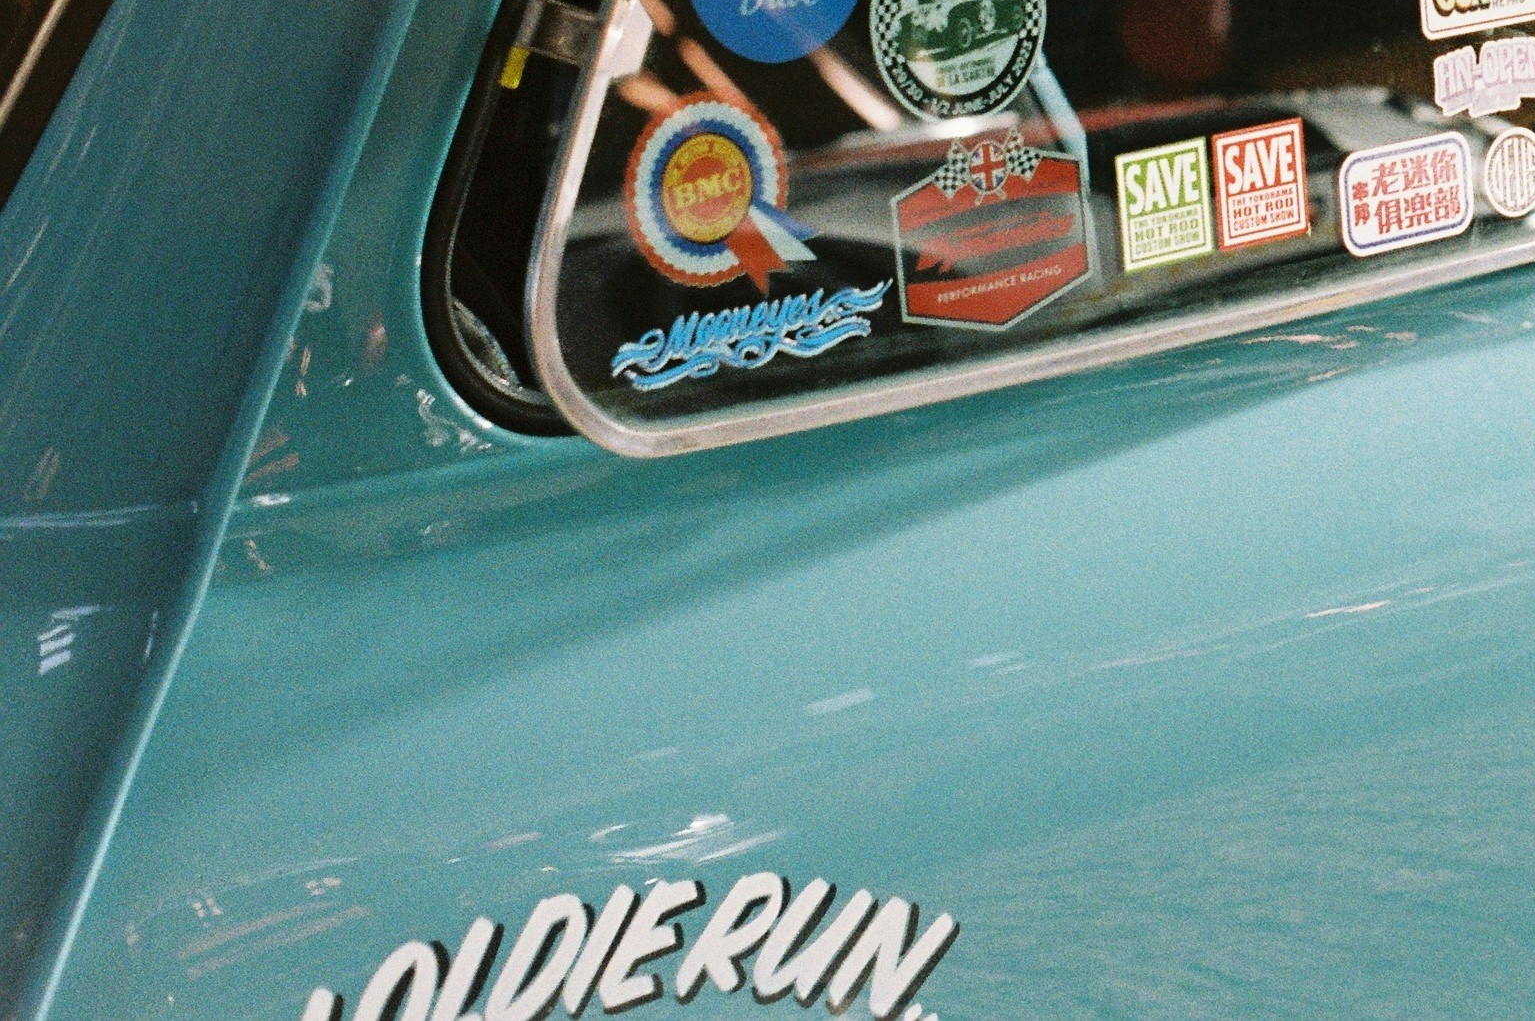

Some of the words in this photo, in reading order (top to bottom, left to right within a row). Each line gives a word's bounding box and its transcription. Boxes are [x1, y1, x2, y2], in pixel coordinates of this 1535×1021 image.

[1125, 151, 1200, 216] SAVE
[1223, 133, 1295, 195] SAVE
[673, 166, 742, 210] BMC
[1233, 203, 1260, 220] HOT
[1265, 197, 1294, 213] ROD
[1233, 214, 1268, 232] CUSTOM
[1270, 208, 1295, 224] SHOW
[1134, 225, 1164, 243] HOT
[1169, 218, 1199, 235] ROD
[936, 275, 1017, 304] PERFORMANCE
[1019, 264, 1062, 284] RACING
